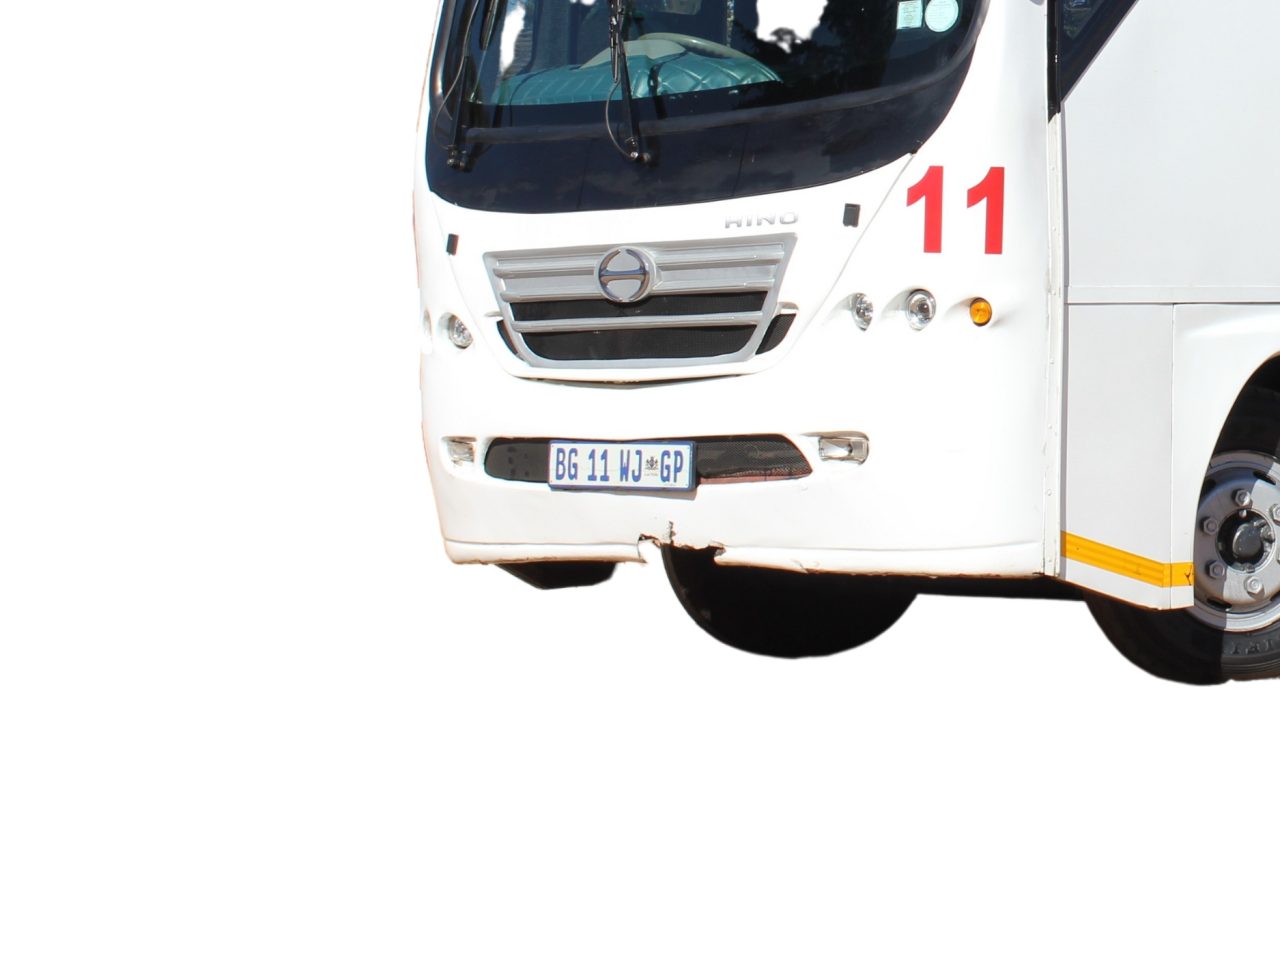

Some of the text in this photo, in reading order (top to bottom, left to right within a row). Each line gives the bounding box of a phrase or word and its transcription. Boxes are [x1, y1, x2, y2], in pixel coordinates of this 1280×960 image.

[724, 212, 799, 229] HINO
[906, 165, 1005, 255] 11
[555, 447, 684, 483] BG 11 WJ GP
